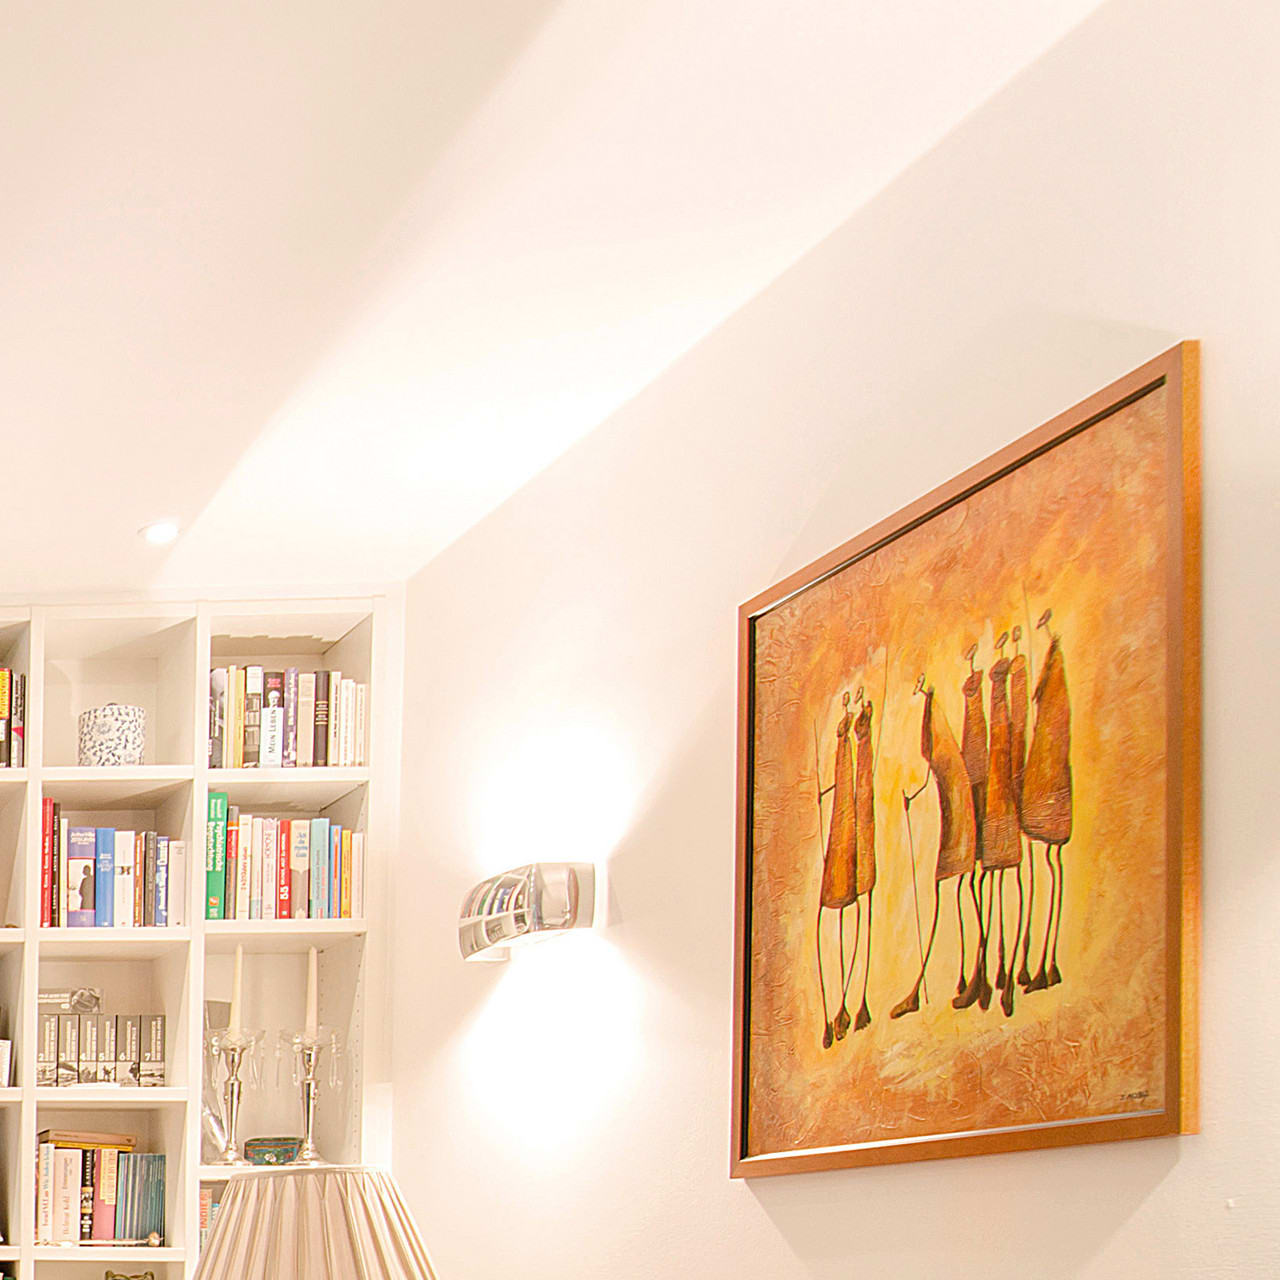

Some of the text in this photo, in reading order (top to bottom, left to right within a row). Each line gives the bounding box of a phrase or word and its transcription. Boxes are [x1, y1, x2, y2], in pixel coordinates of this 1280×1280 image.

[39, 1053, 45, 1061] 2
[119, 1052, 126, 1061] 6
[145, 1052, 151, 1061] 7
